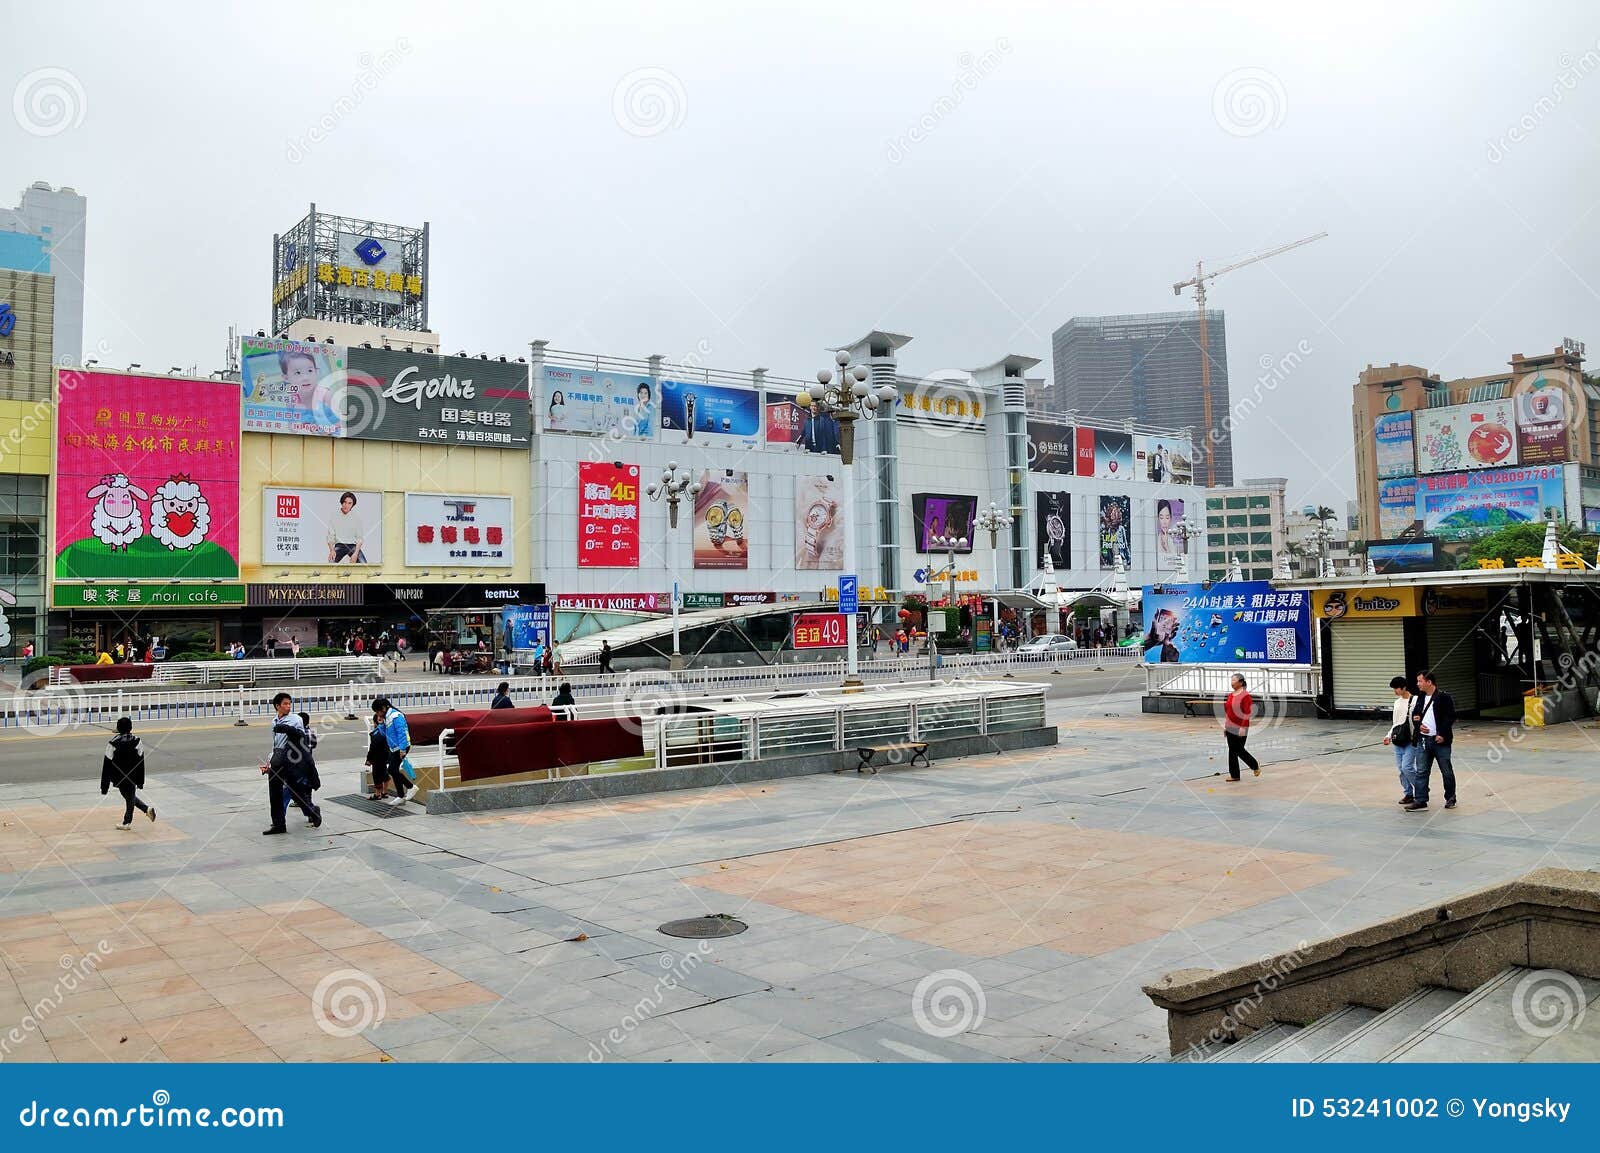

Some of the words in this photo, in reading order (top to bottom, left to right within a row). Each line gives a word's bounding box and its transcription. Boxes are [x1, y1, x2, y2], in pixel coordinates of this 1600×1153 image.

[441, 408, 512, 427] 国美电器
[418, 428, 448, 439] 吉大店
[1472, 468, 1556, 486] 13928097781
[279, 498, 296, 506] UNI
[279, 507, 298, 516] QLO
[152, 592, 180, 602] mori
[188, 590, 218, 602] café
[268, 589, 317, 602] MYFACE
[485, 588, 520, 599] teemix
[559, 598, 605, 609] BEAUTY
[607, 598, 646, 609] KOREA
[1182, 595, 1246, 609] 24小时通关
[1251, 593, 1303, 608] 租房买房
[1243, 609, 1299, 623] 澳门搜房网
[797, 628, 820, 643] 全场
[822, 620, 840, 643] 49
